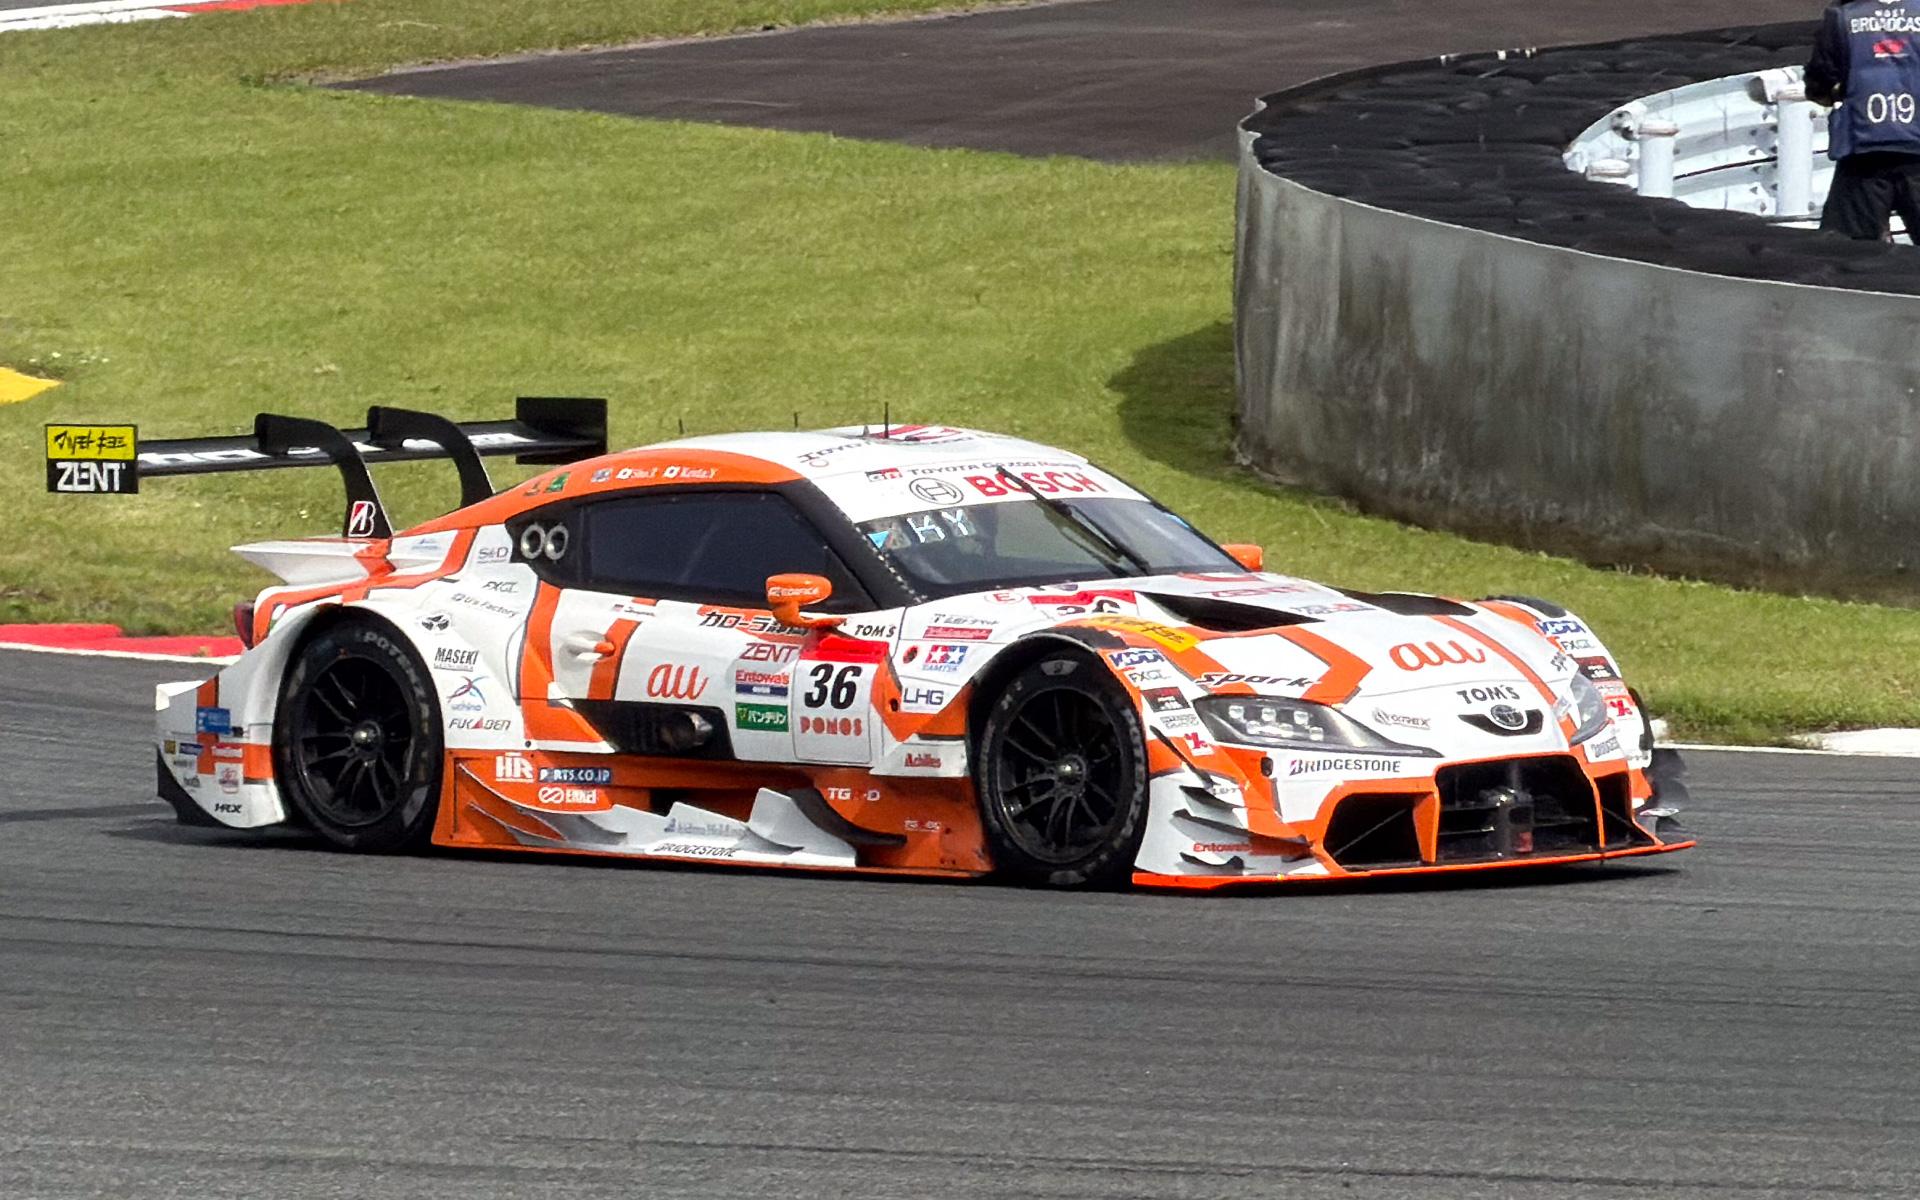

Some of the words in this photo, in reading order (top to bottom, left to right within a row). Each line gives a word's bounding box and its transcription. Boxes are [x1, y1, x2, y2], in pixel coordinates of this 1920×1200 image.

[1867, 92, 1915, 123] 019
[56, 461, 121, 492] ZENT
[906, 463, 978, 476] TOYOTA
[963, 471, 1109, 497] BOSCH
[434, 647, 479, 665] MASEKI
[739, 642, 799, 662] ZENT
[1388, 640, 1486, 671] au
[646, 663, 709, 700] au
[804, 663, 862, 710] 36
[1195, 673, 1314, 687] spark
[903, 688, 945, 706] LHG
[1456, 684, 1521, 704] TOM'S
[800, 716, 862, 737] PONOS
[1288, 758, 1401, 777] BRIDGESTONE
